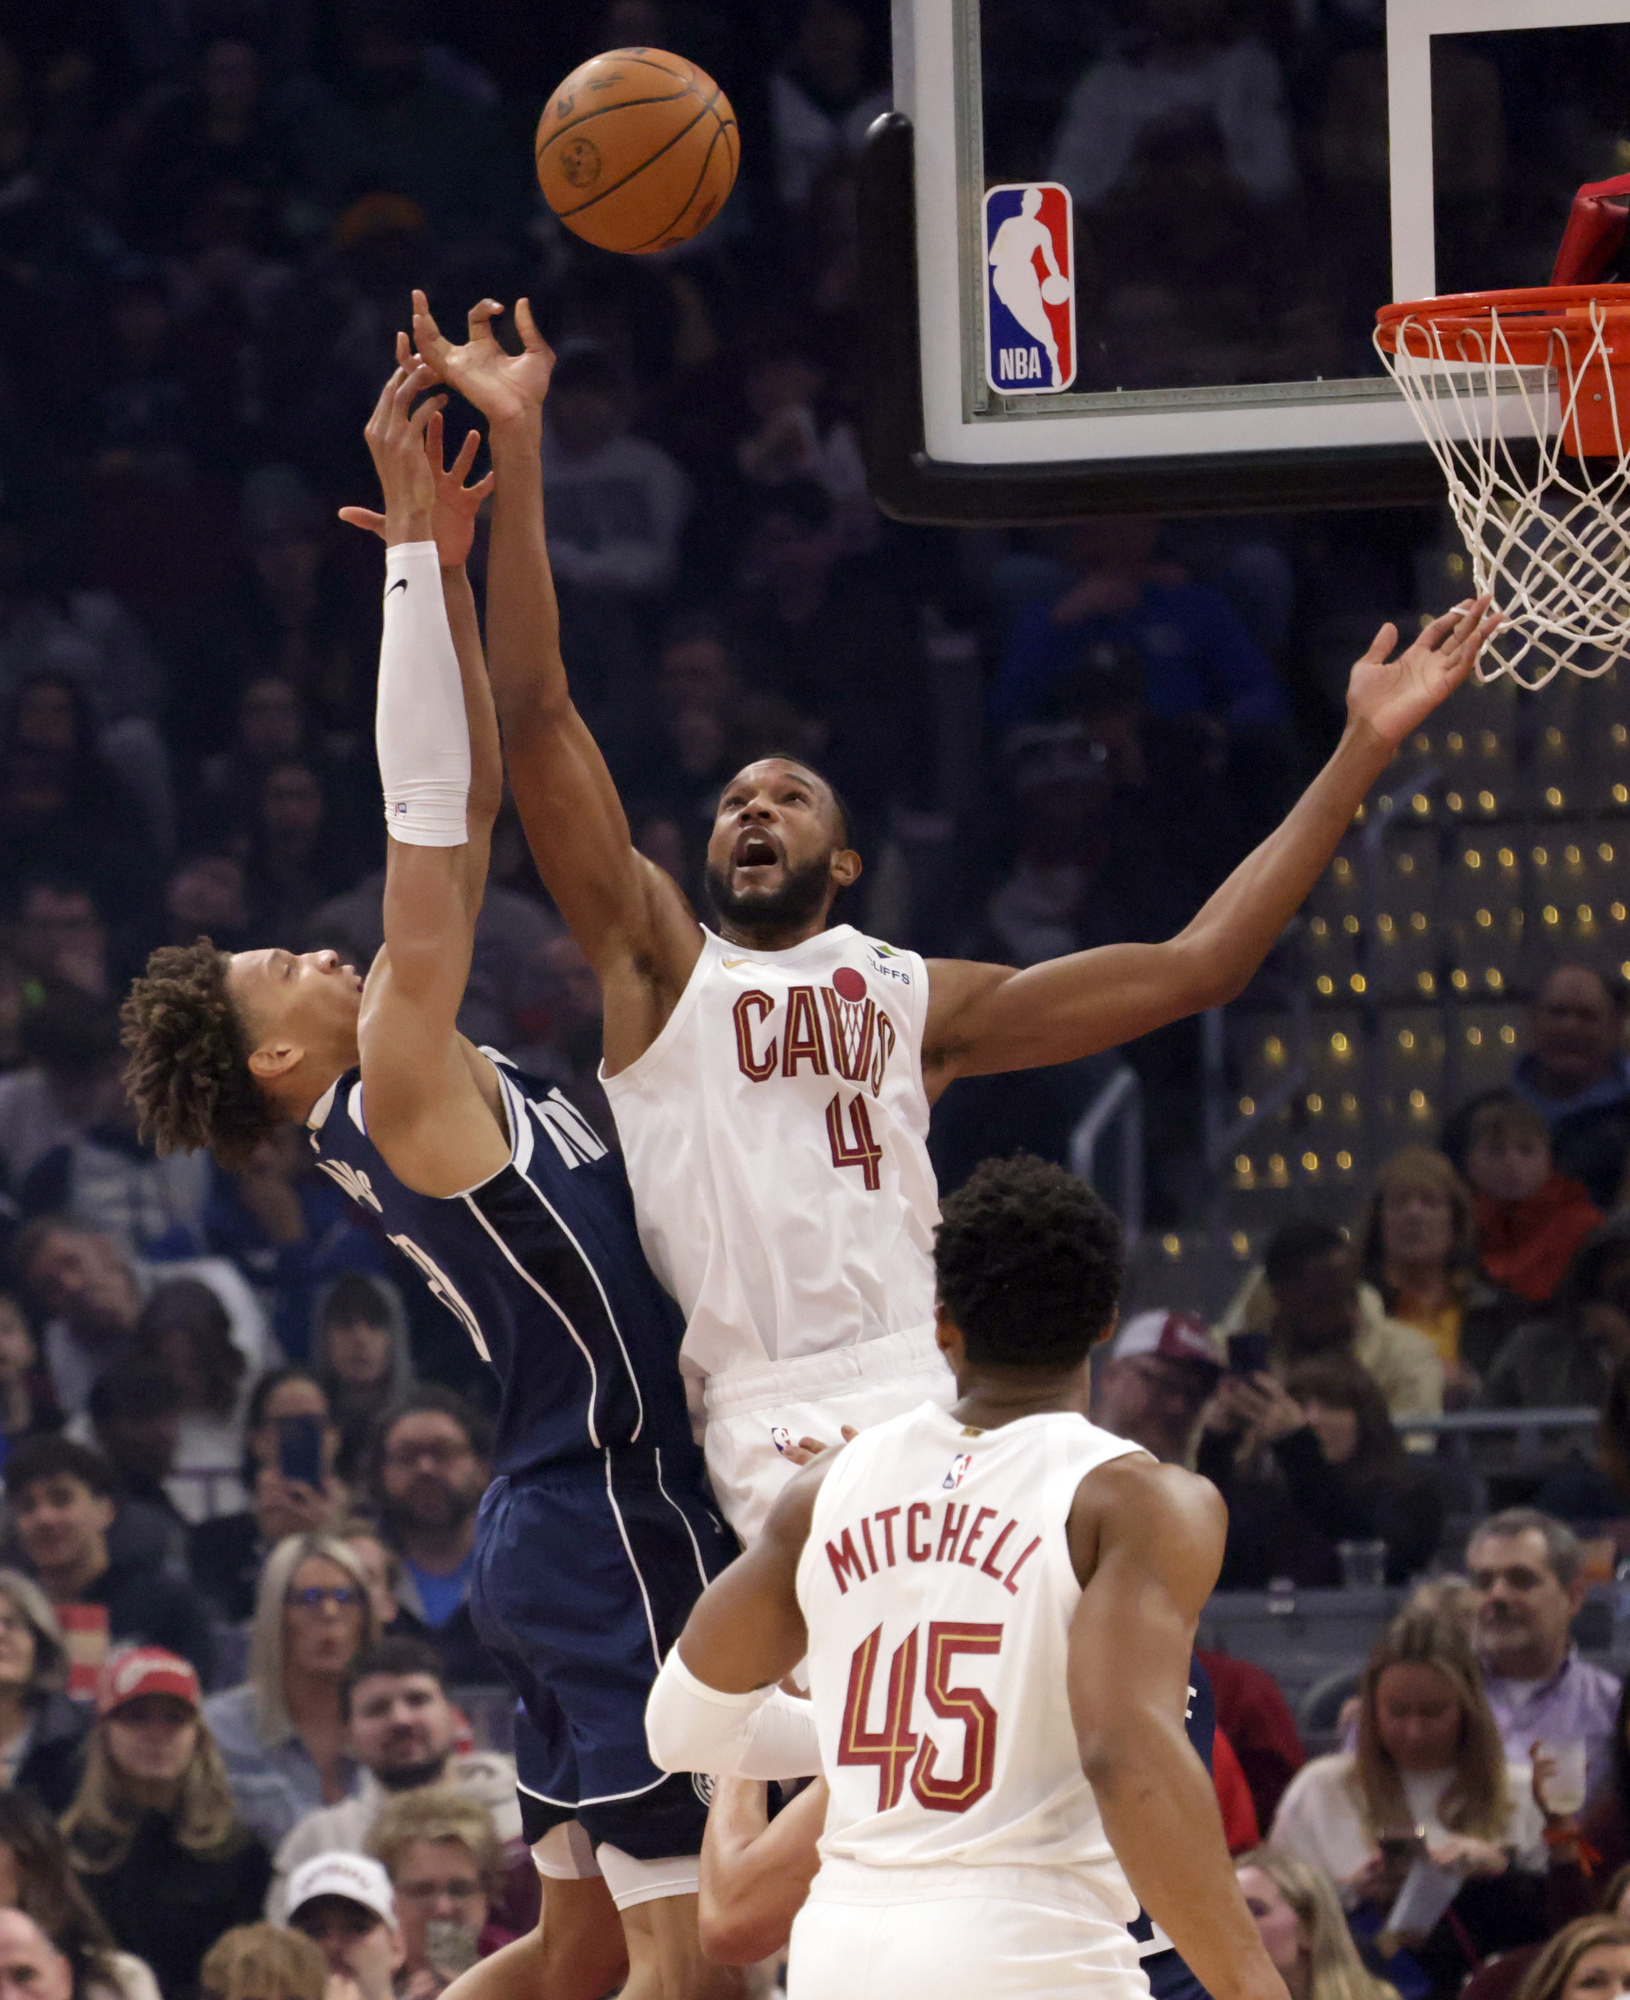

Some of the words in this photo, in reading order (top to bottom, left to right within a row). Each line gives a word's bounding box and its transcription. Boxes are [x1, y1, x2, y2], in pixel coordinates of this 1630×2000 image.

[1000, 347, 1042, 380] NBA
[733, 986, 895, 1098] CAVS
[826, 1091, 882, 1191] 4
[825, 1502, 1042, 1595] MITCHELL
[837, 1621, 1004, 1813] 45
